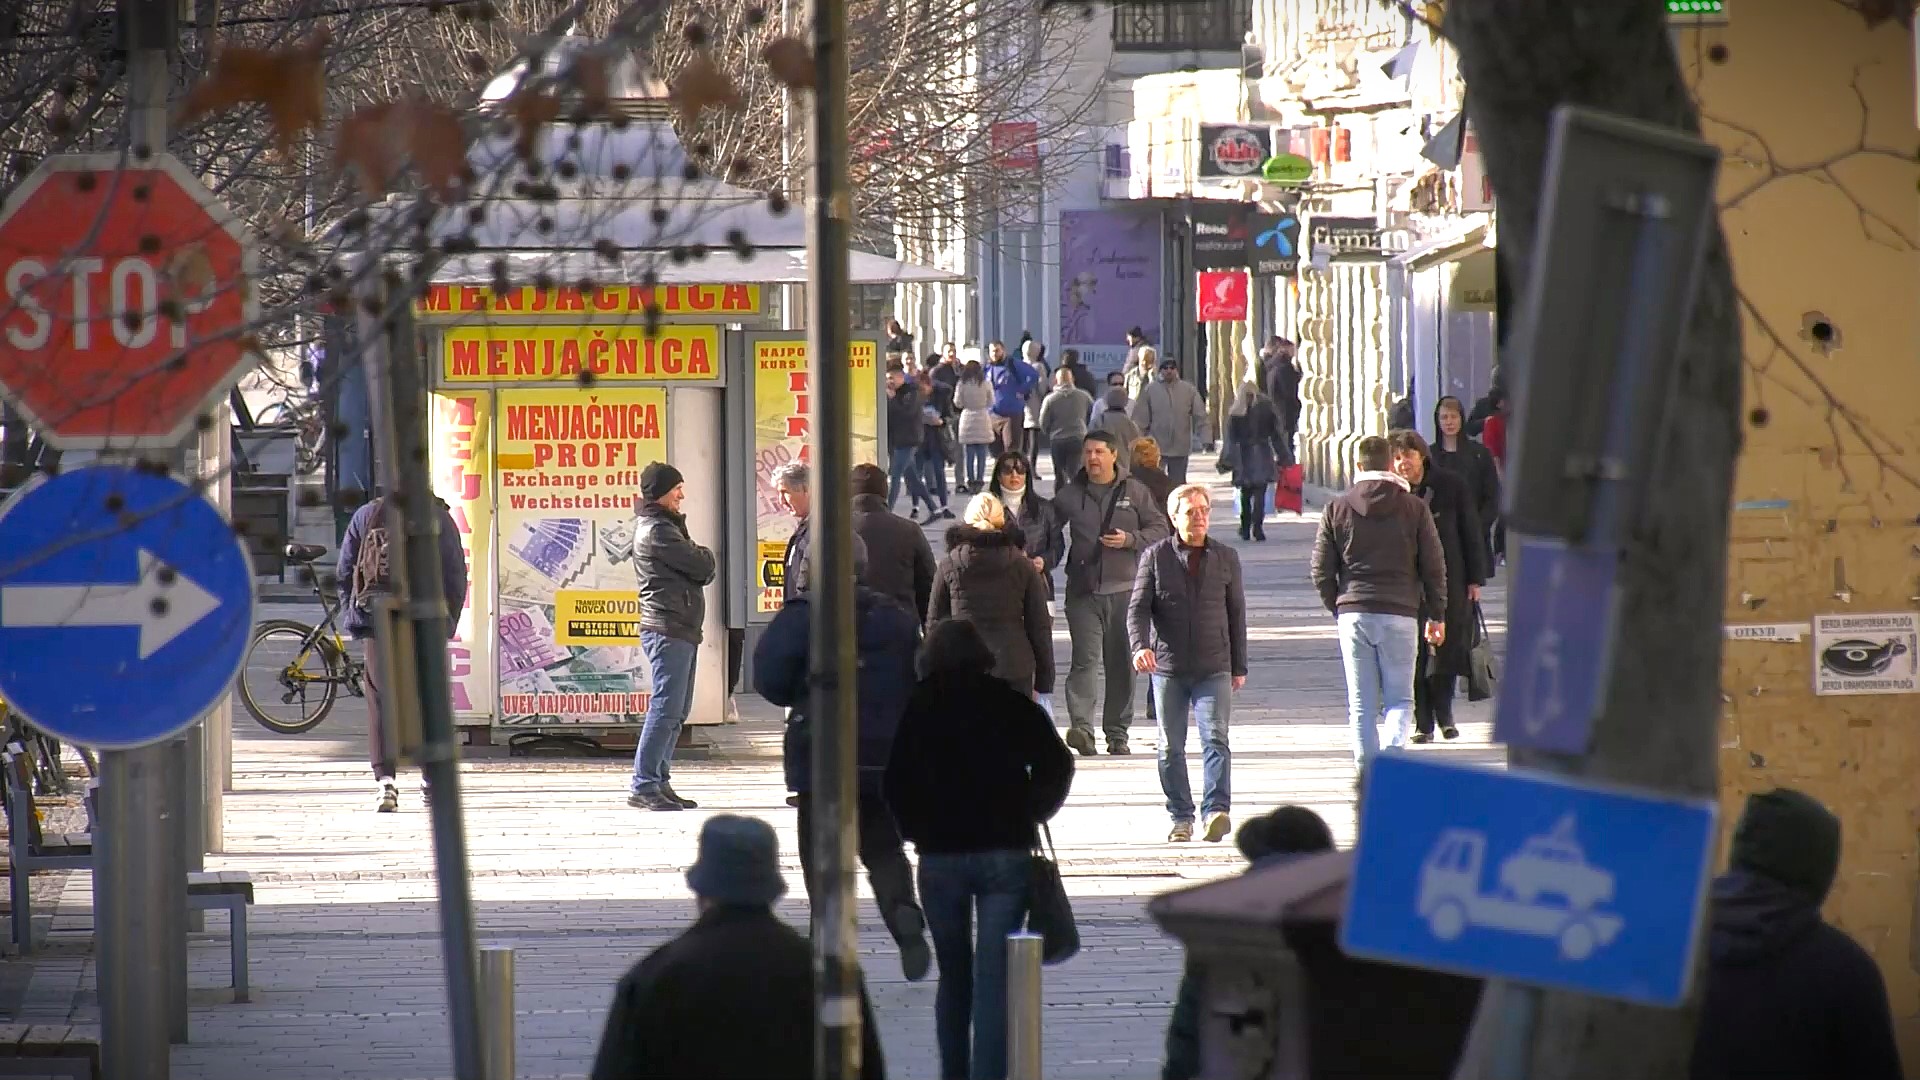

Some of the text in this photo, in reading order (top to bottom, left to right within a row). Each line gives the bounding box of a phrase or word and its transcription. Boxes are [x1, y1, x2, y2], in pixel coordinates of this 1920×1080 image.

[452, 331, 711, 376] MENJAČNICA
[760, 360, 797, 369] KURS
[507, 396, 660, 441] MENJAČNICA
[534, 443, 637, 467] PROFI
[503, 472, 598, 489] Exchange
[575, 605, 606, 614] NOVCA
[503, 694, 535, 714] UVEK
